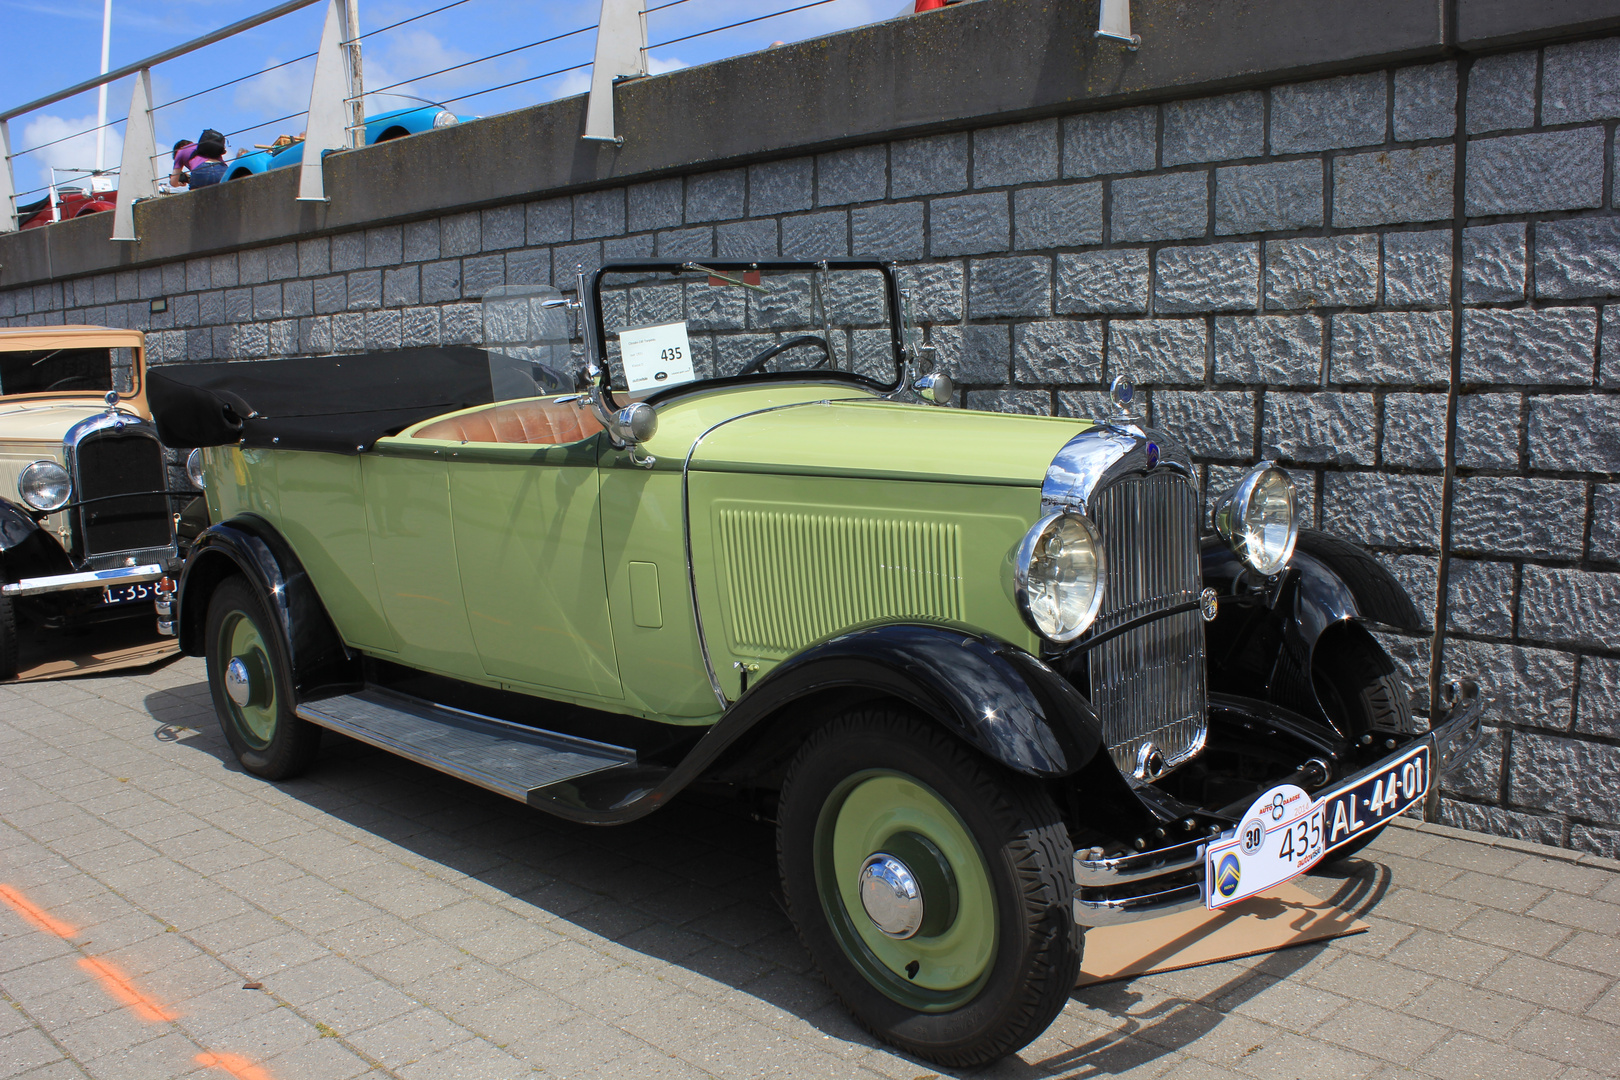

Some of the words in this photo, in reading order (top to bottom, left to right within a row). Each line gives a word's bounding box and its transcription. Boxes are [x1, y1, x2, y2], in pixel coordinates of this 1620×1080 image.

[661, 346, 683, 361] 435
[1259, 805, 1273, 815] AUTO
[1272, 793, 1284, 821] 8
[1246, 827, 1261, 849] 30
[1279, 811, 1320, 862] 435
